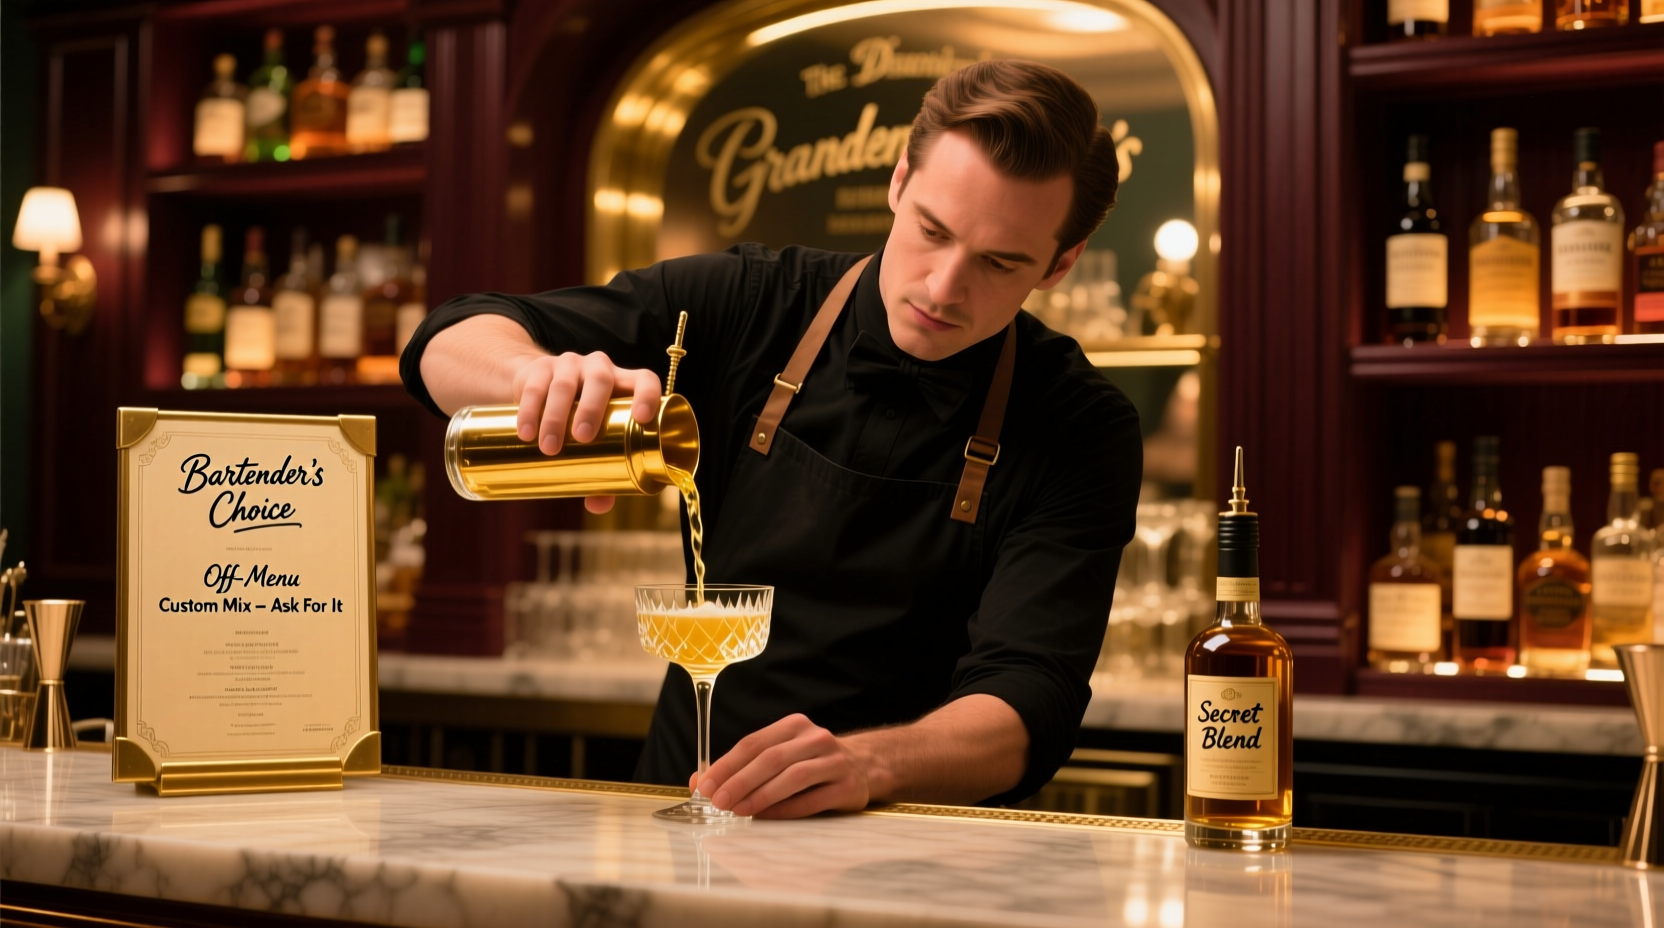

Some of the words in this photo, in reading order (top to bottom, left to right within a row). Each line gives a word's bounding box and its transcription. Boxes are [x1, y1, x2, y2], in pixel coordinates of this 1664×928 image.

[178, 453, 324, 494] Bartender's
[209, 490, 296, 529] Choice
[159, 597, 218, 613] Custom
[223, 597, 251, 613] Mix
[271, 597, 300, 613] Ask
[303, 597, 327, 613] For
[332, 597, 343, 613] It
[1197, 700, 1264, 724] Secret
[1202, 726, 1263, 750] Blend
